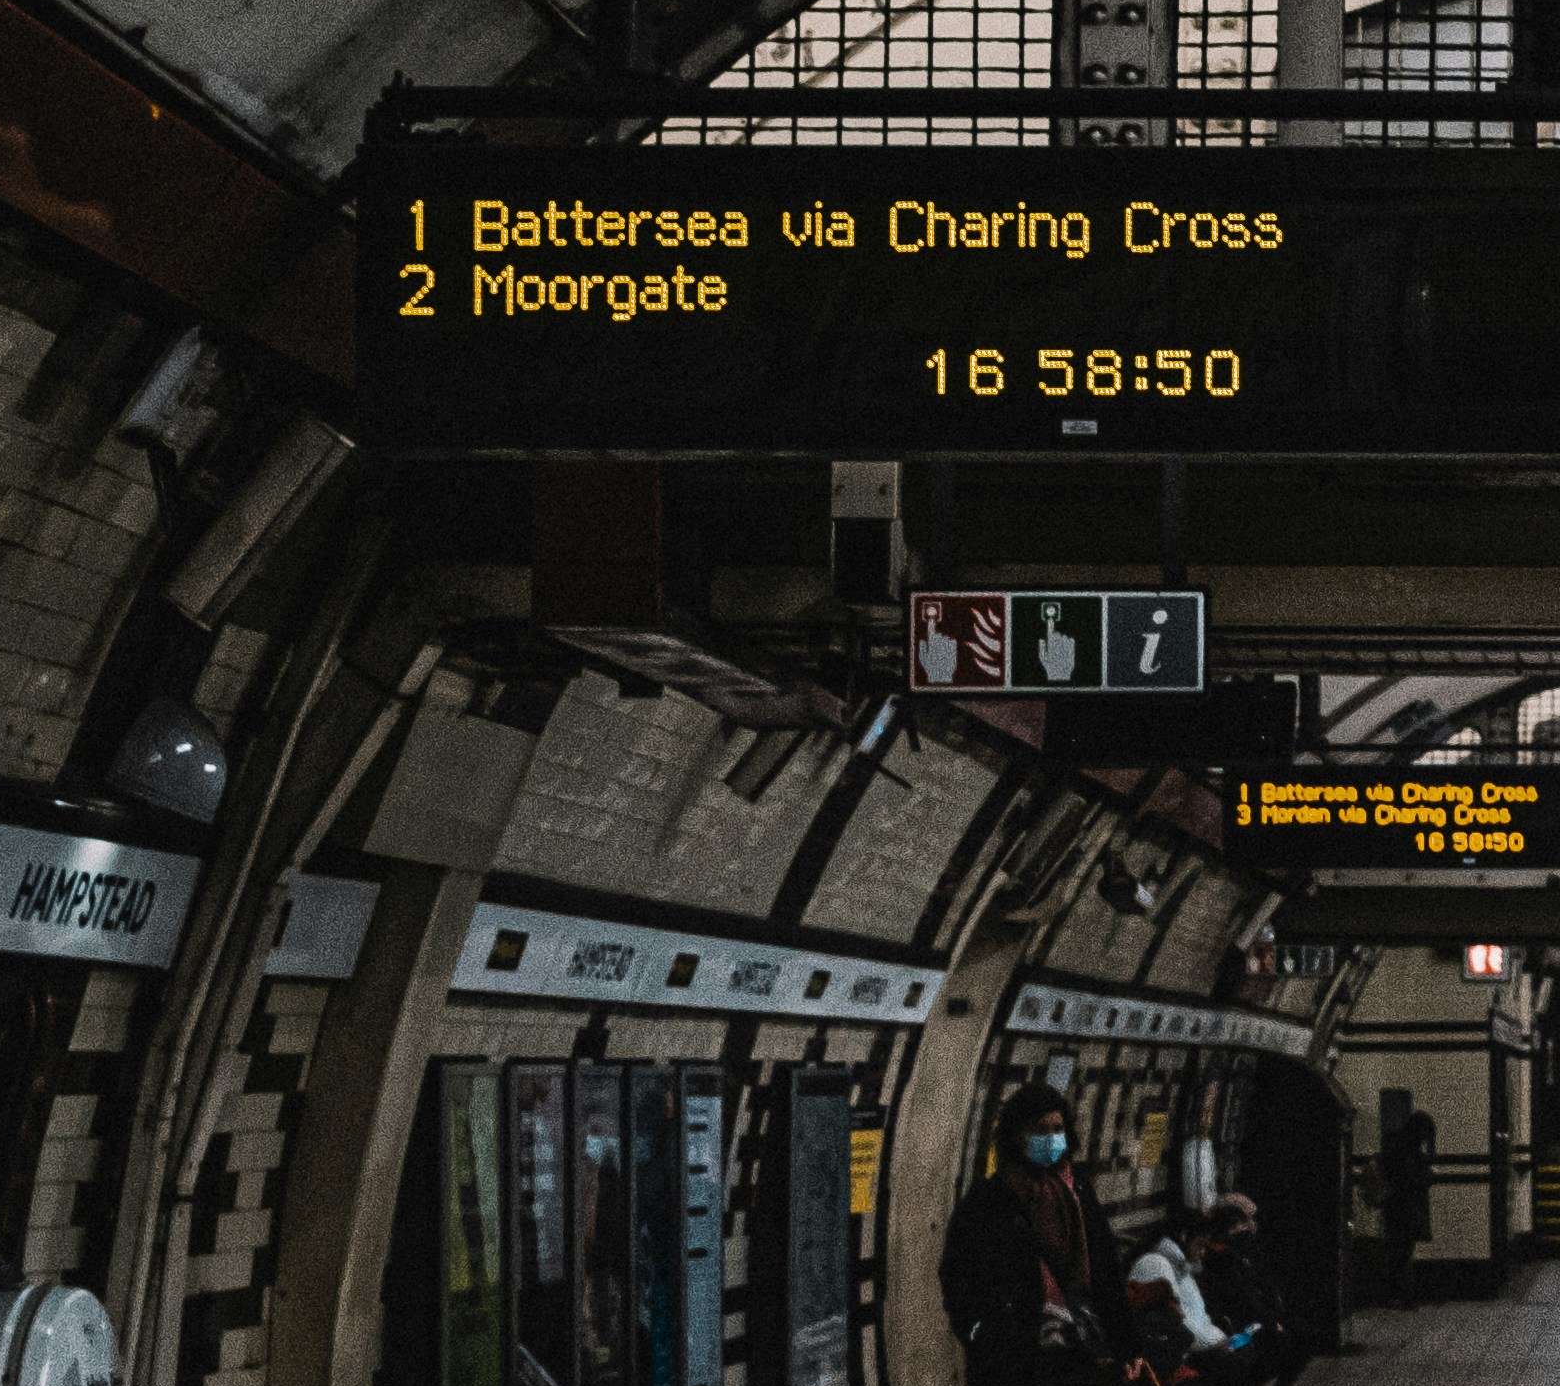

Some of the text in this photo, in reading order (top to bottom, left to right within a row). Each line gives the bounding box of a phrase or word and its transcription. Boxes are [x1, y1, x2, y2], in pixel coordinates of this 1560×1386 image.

[409, 199, 425, 252] 1
[472, 199, 749, 252] Battersea
[782, 200, 855, 248] via
[889, 200, 1091, 259] Charing
[1124, 201, 1284, 254] Cross
[399, 263, 436, 316] 2
[472, 263, 728, 322] Moorgate
[925, 348, 1240, 398] 16 58:50
[9, 860, 157, 936] HAMPSTEAD
